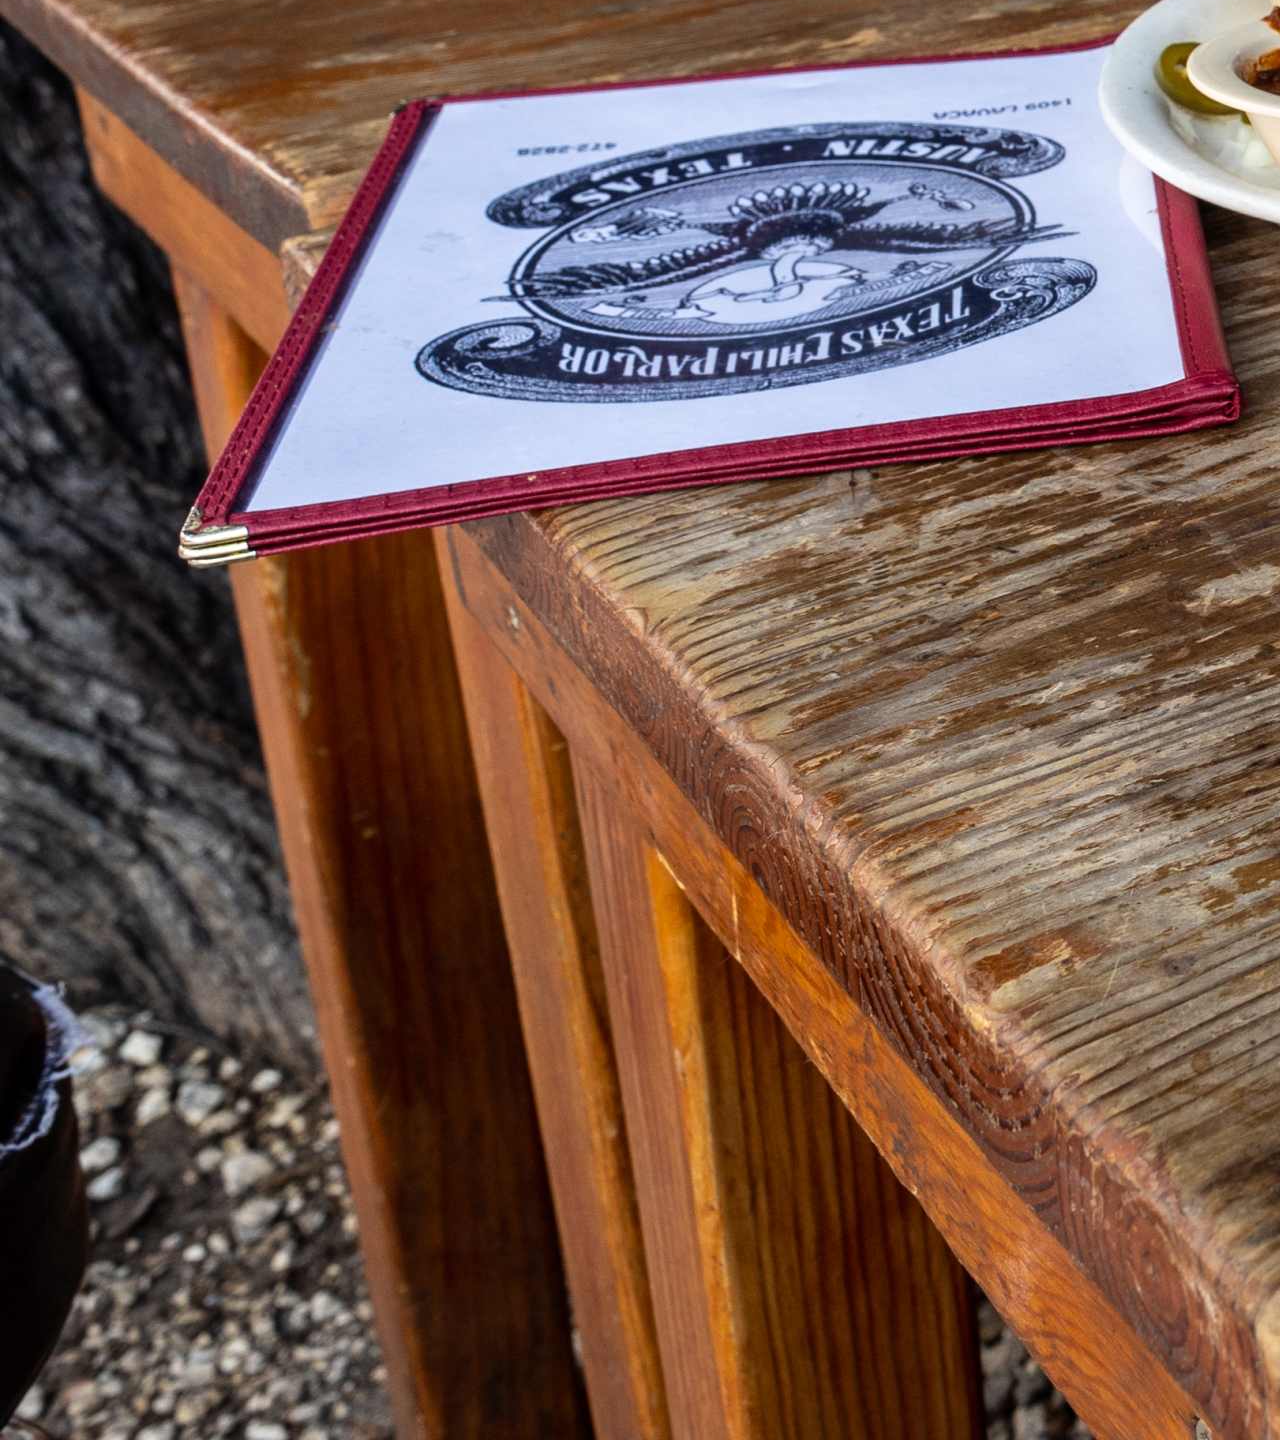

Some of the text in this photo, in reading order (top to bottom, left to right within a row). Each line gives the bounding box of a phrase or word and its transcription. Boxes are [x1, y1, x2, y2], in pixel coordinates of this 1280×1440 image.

[933, 97, 1072, 121] 1409 LAVACA
[571, 137, 997, 208] AUSTIN TEXAS
[557, 284, 972, 381] TEXAS CHILI PARLOR
